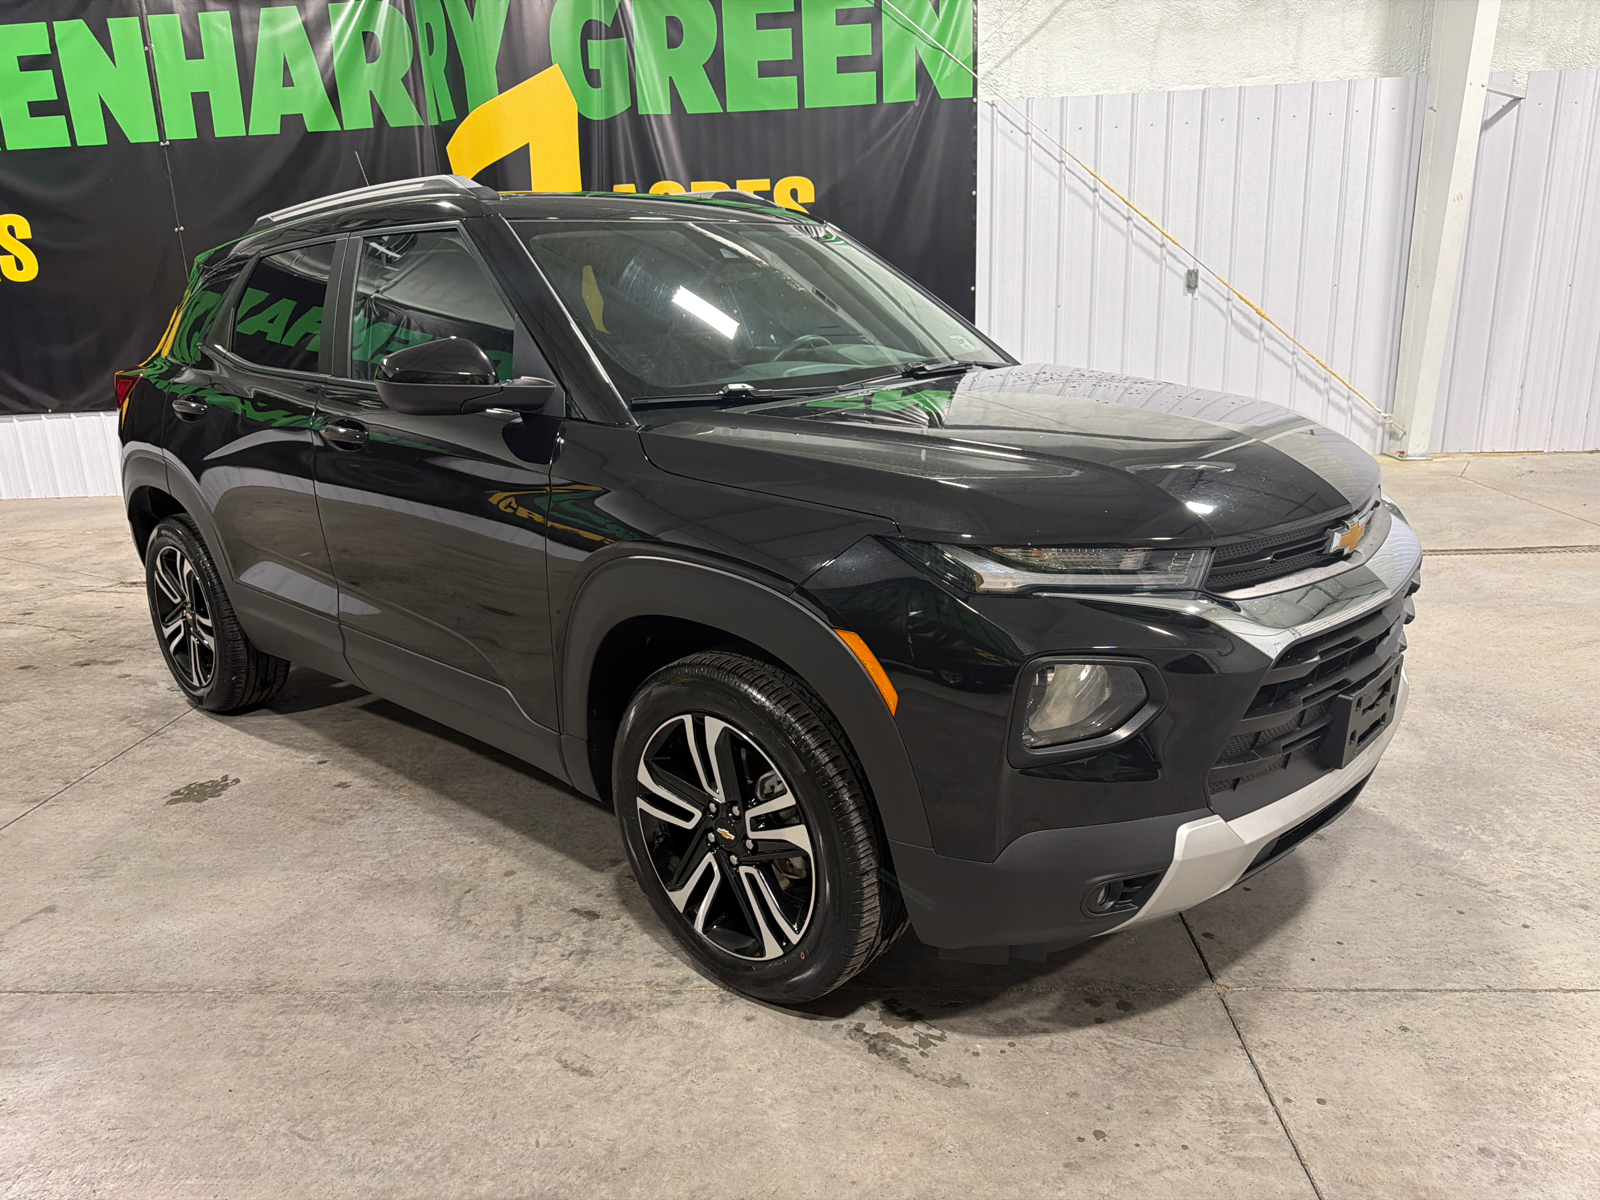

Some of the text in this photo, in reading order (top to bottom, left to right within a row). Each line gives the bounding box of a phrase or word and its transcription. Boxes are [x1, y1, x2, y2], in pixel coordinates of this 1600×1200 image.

[0, 16, 160, 151] EN
[147, 0, 974, 141] HARRY GREEN
